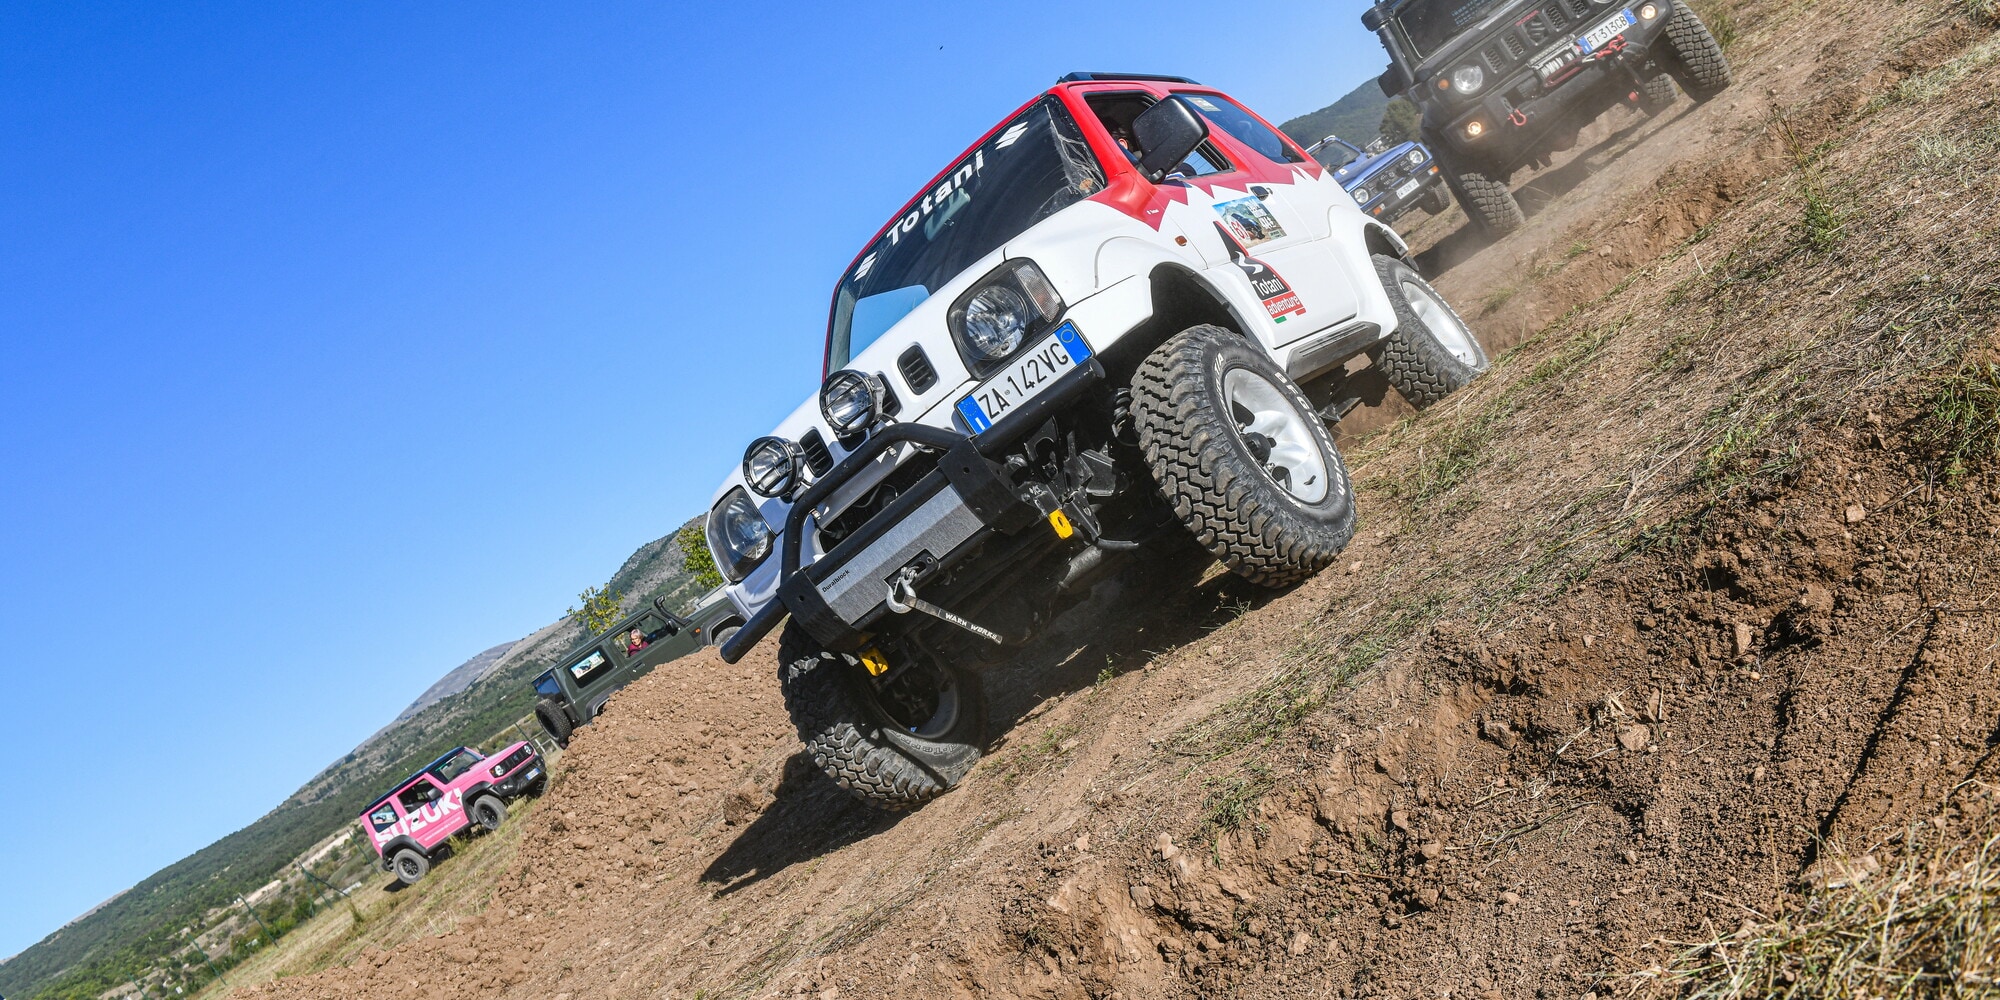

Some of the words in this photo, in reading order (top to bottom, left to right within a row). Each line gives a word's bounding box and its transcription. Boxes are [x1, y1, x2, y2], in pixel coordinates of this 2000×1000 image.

[886, 149, 984, 246] Totani
[1251, 274, 1285, 296] Totani
[1266, 296, 1300, 315] adventure
[822, 569, 850, 593] Duralblock
[945, 612, 968, 627] WARN
[970, 623, 998, 640] WORKS
